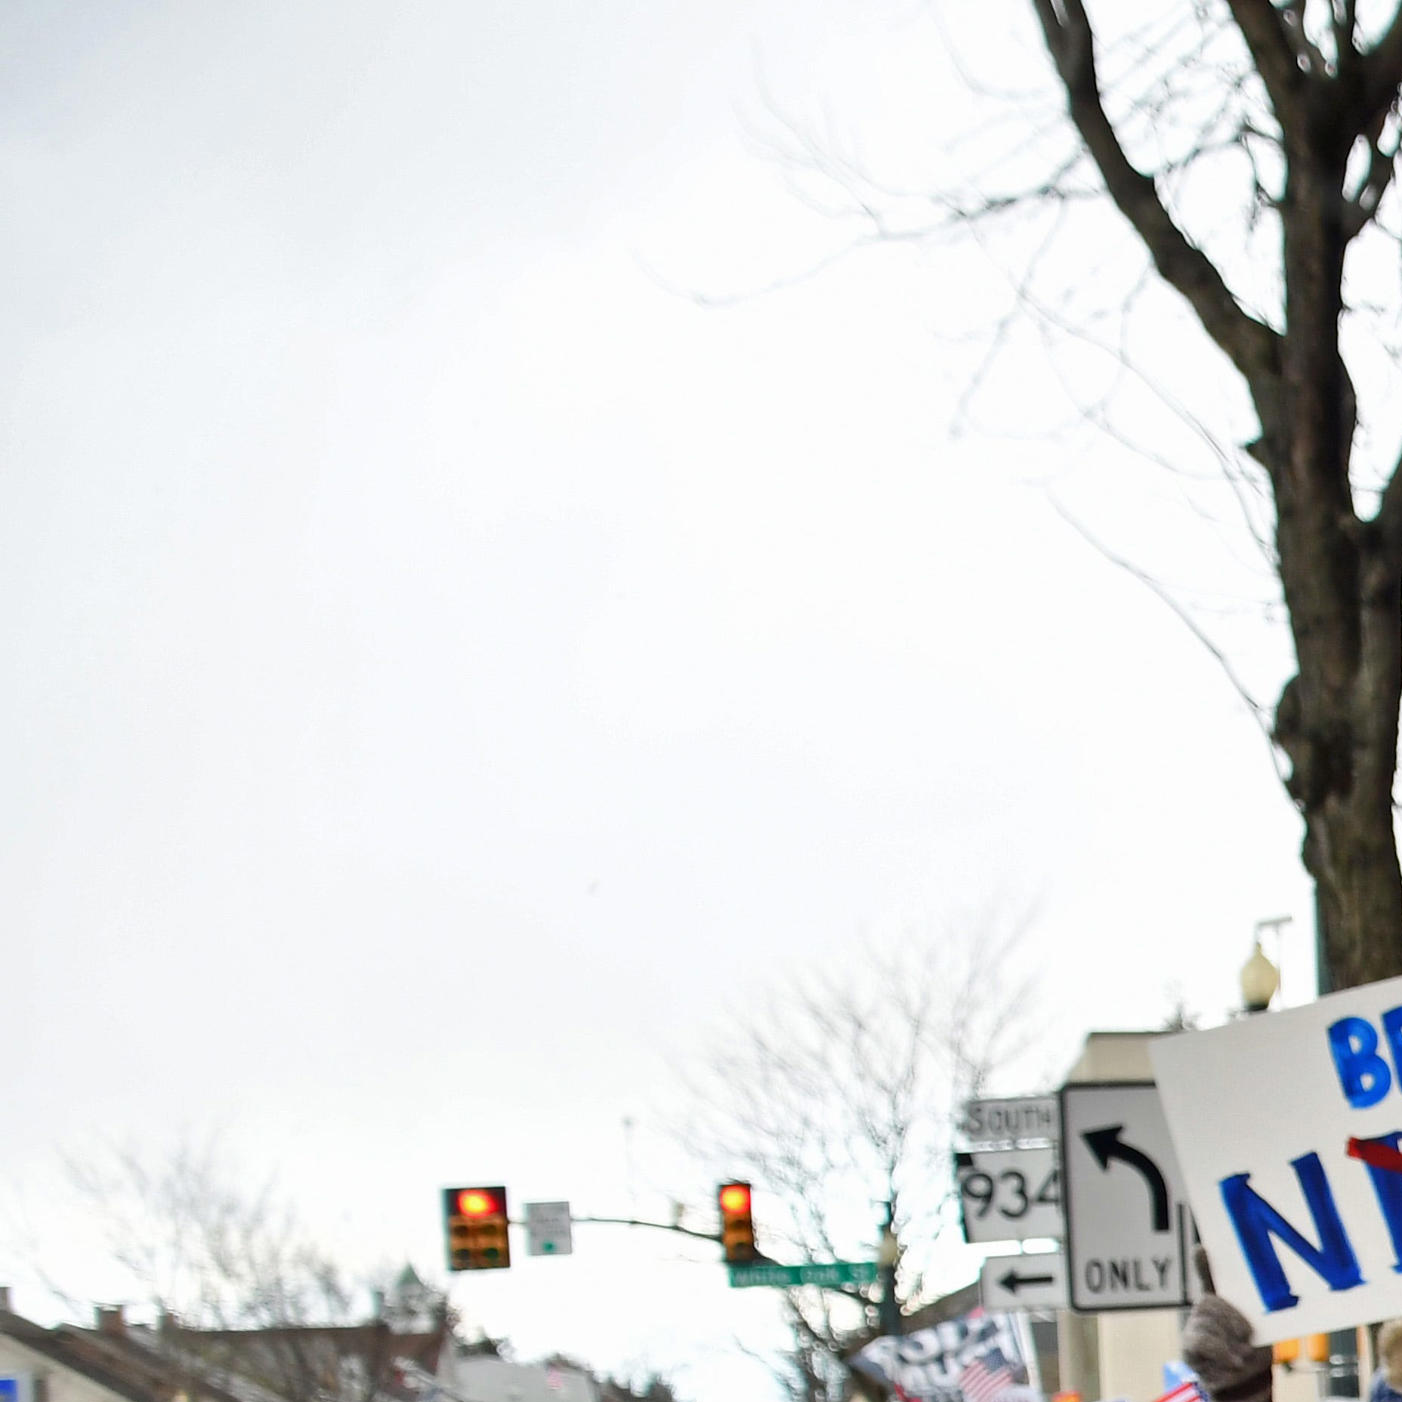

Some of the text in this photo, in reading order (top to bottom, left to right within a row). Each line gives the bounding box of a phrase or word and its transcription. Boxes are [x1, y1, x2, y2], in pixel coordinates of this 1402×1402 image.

[966, 1105, 1052, 1134] SOUTH
[961, 1169, 1061, 1221] 934
[1085, 1258, 1172, 1295] ONLY
